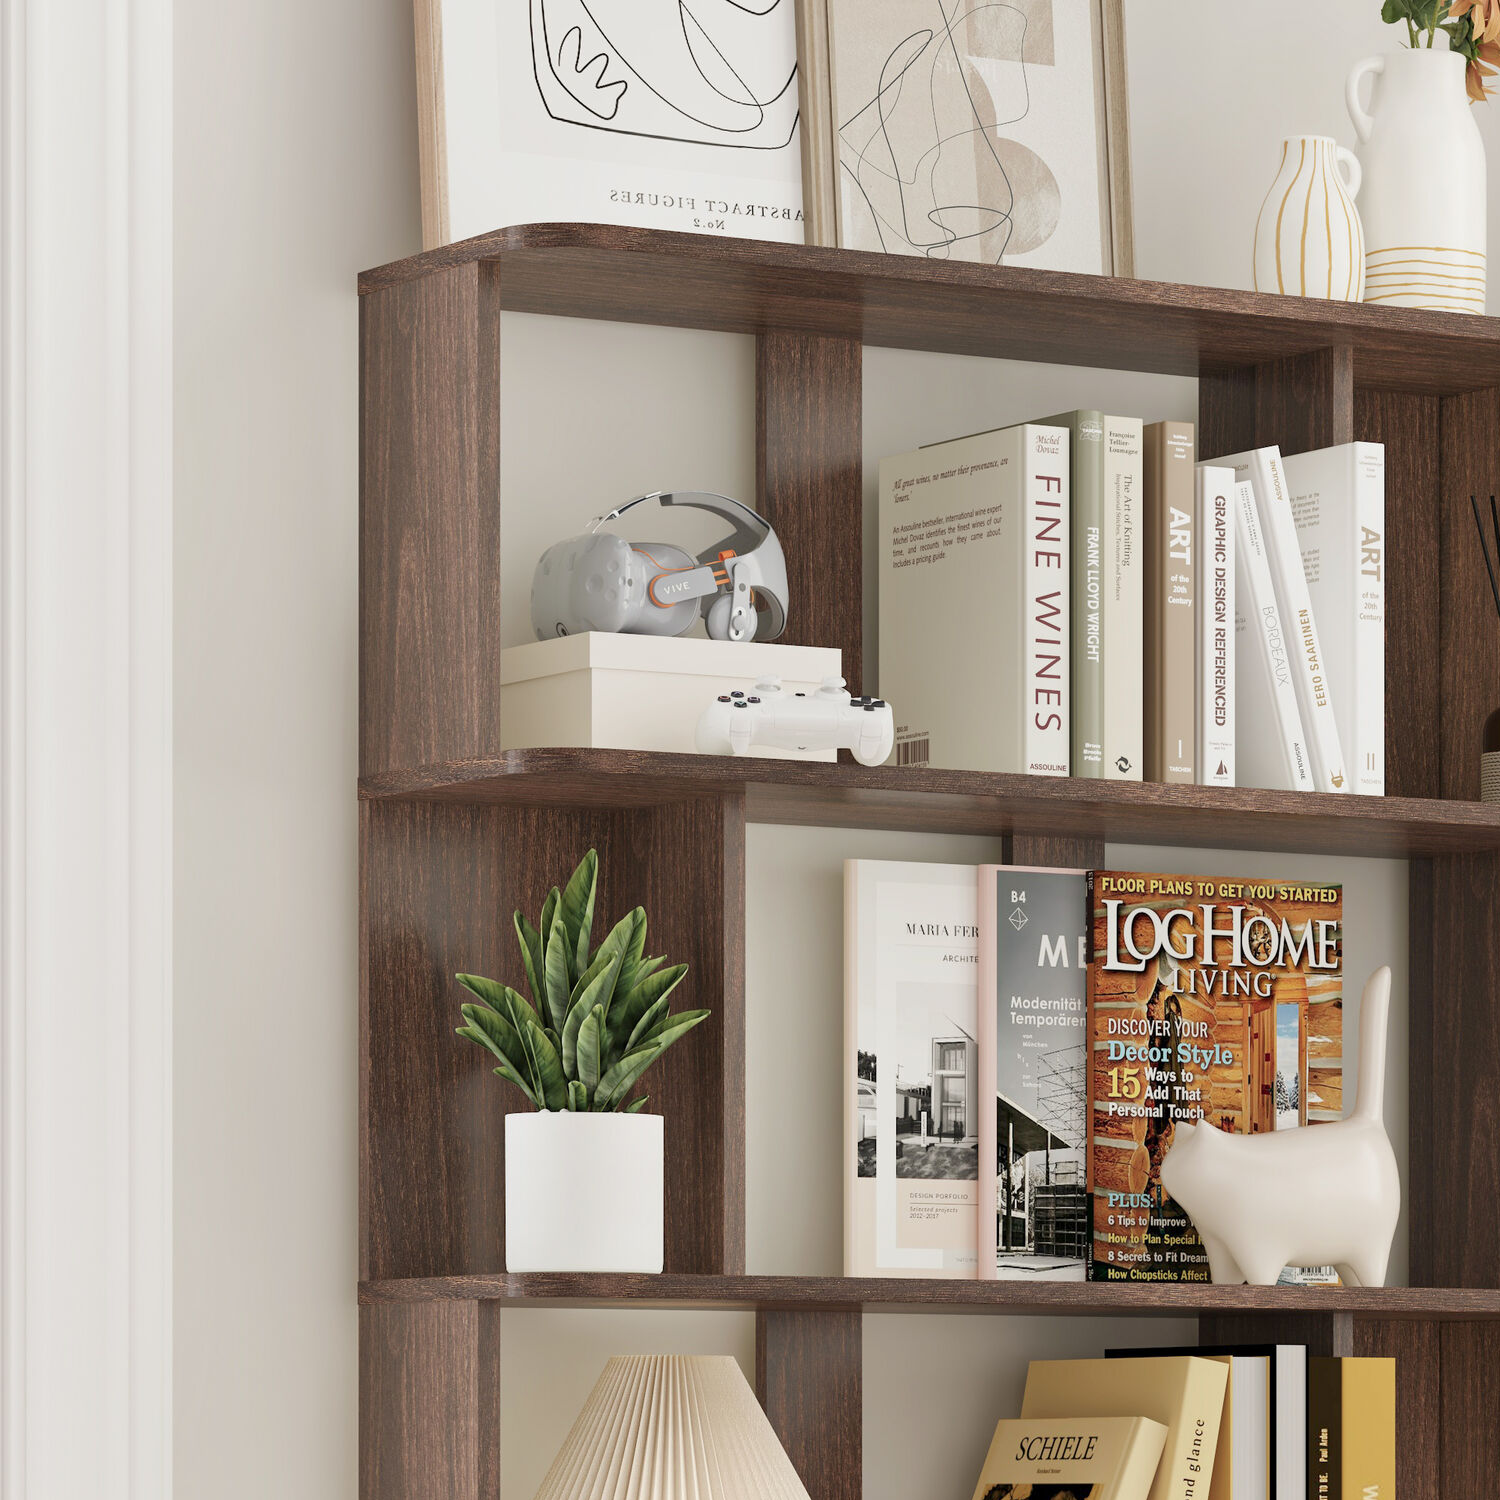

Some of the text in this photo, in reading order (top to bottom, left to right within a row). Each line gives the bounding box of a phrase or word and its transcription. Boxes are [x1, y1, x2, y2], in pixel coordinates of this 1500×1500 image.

[1035, 434, 1061, 446] Michel
[1036, 445, 1060, 455] Dovaz
[1269, 460, 1282, 501] ASSOULINE
[1121, 474, 1133, 566] The Art of Knitting
[1169, 506, 1191, 565] ART
[1361, 526, 1381, 582] ART
[664, 581, 691, 595] VIVE
[1035, 475, 1061, 731] FINE WINES
[1087, 527, 1099, 663] FRANK LLOYD WRIGHT
[1168, 596, 1192, 607] Century
[1215, 495, 1226, 726] GRAPHIC DESIGN REFERENCED
[1263, 606, 1289, 687] BORDEAUX
[1299, 608, 1327, 707] EERO SAARINEN
[1030, 763, 1067, 772] ASSOULINE
[1293, 742, 1305, 780] ASSOULINE
[1011, 890, 1026, 903] B4
[1102, 877, 1337, 902] FLOOR PLANS TO GET YOU STARTED
[1108, 1018, 1208, 1038] DISCOVER YOUR
[1108, 1040, 1233, 1070] Decor Style
[1107, 1067, 1141, 1099] 15
[1108, 1103, 1204, 1119] Personal Touch
[1108, 1215, 1186, 1228] 6 Tips to Improve
[1015, 1436, 1098, 1461] SCHIELE
[1189, 1419, 1205, 1472] glance
